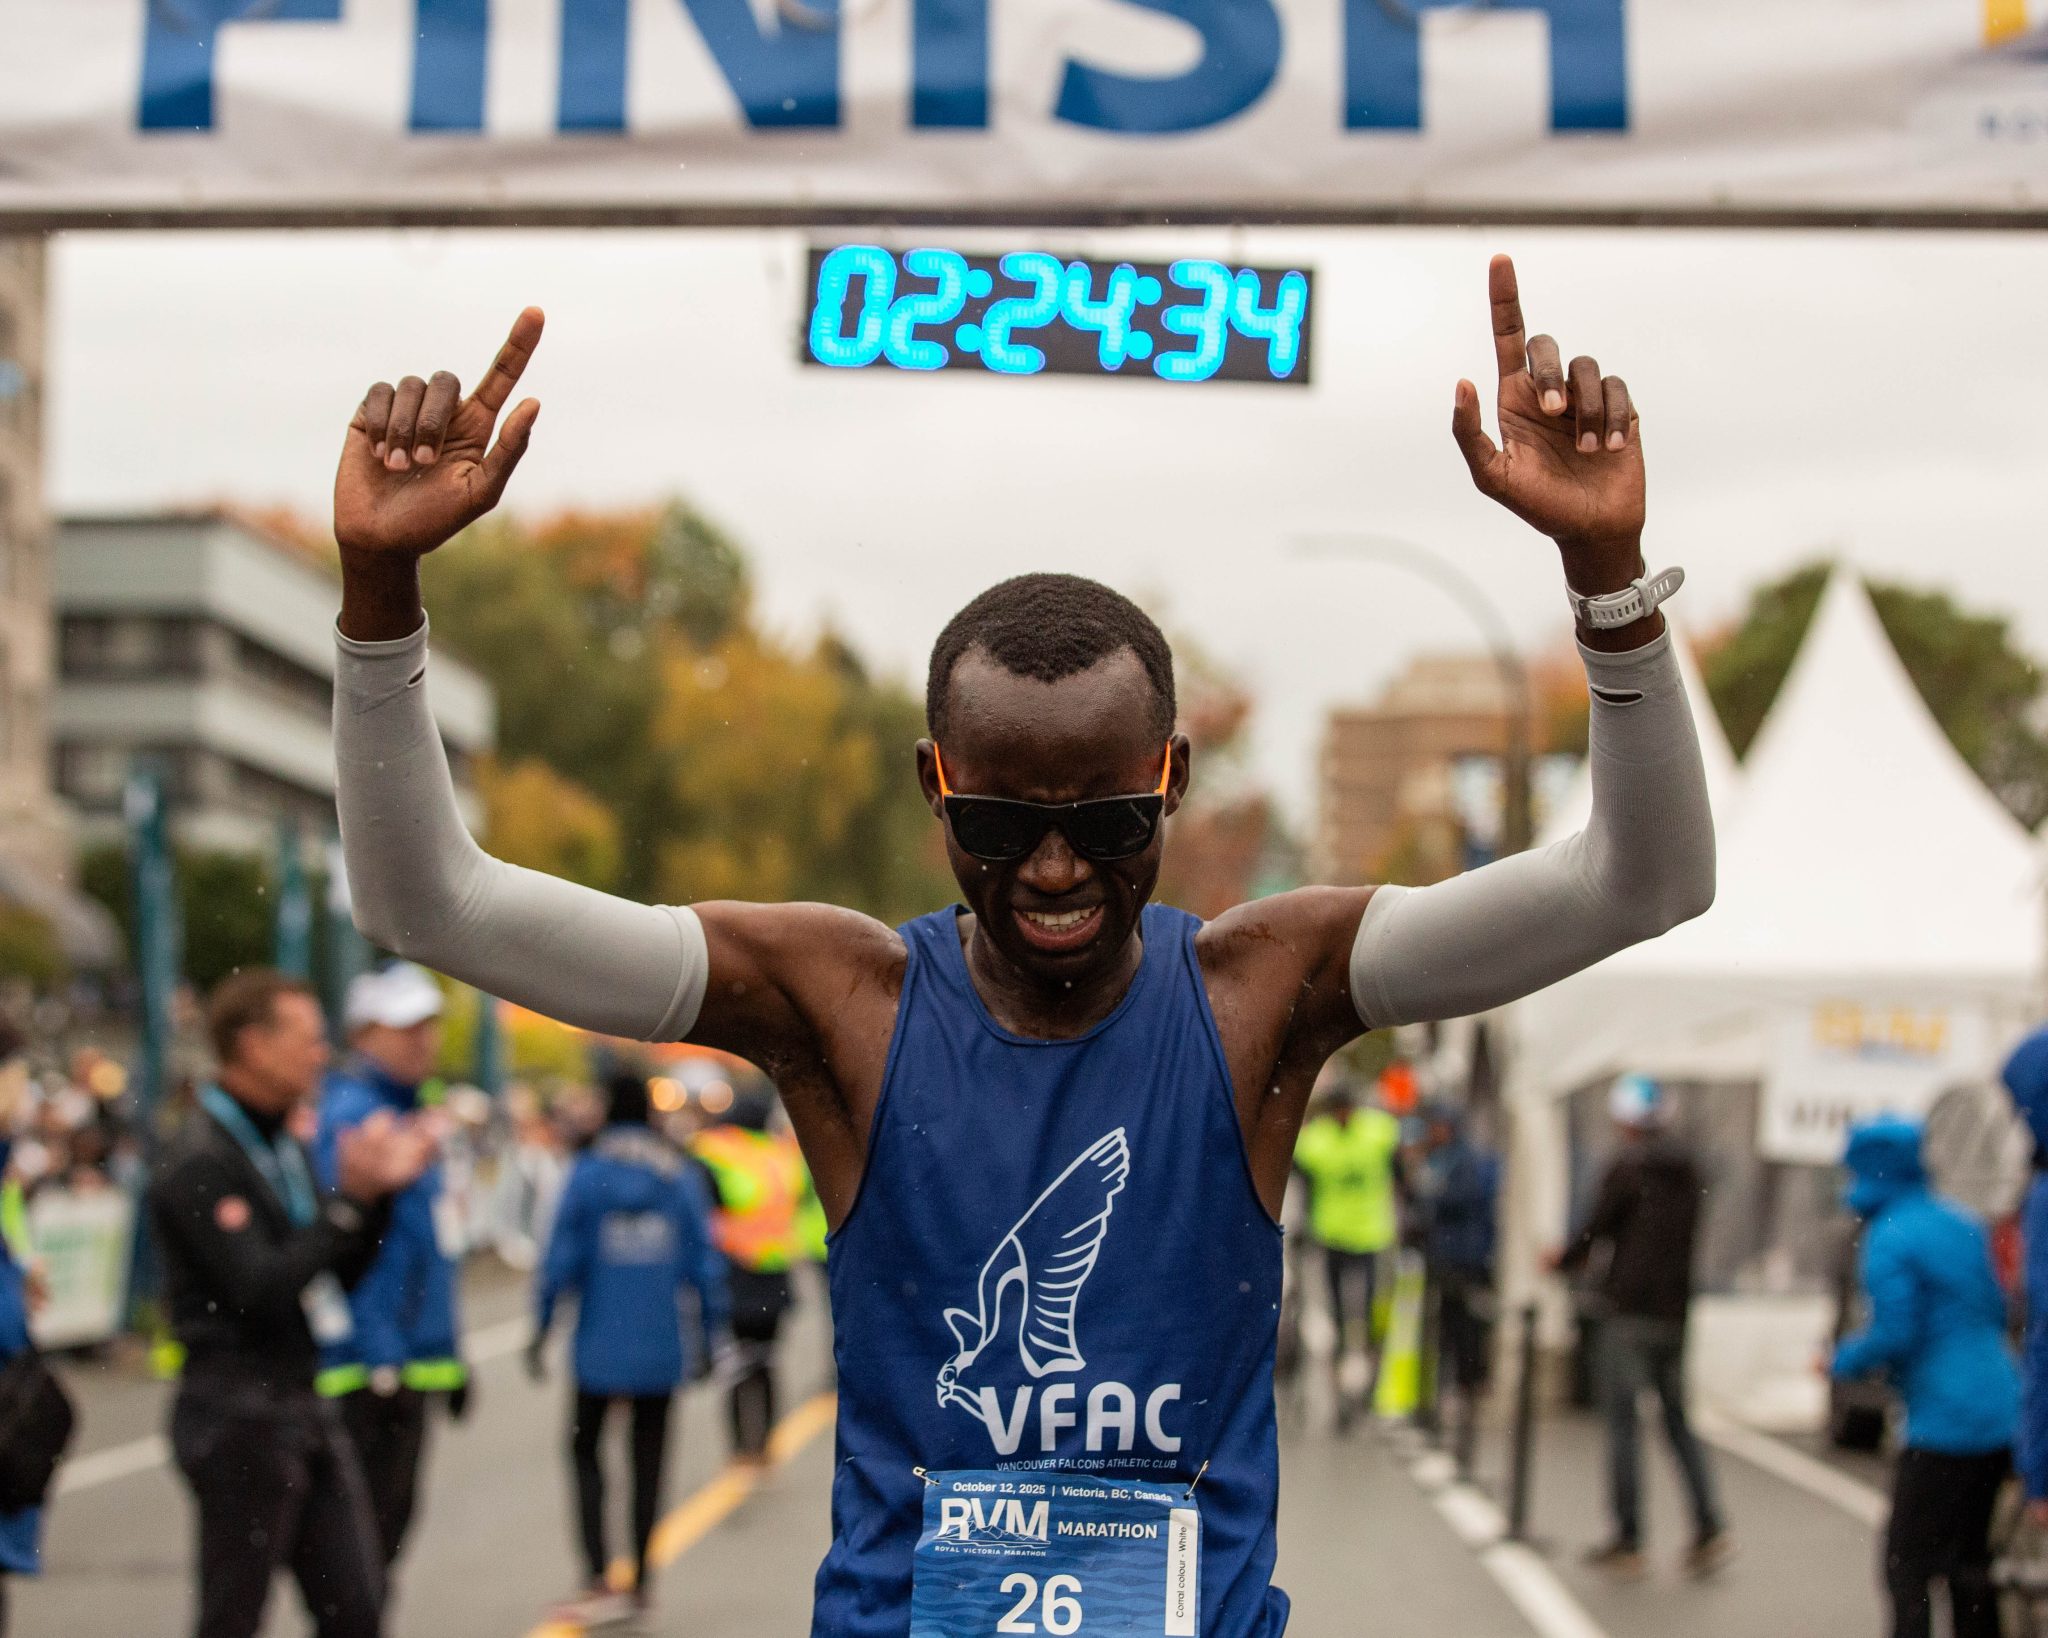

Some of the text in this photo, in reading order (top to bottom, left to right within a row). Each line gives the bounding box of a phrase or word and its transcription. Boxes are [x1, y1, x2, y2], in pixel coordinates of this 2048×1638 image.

[809, 245, 1307, 381] 02:24:34
[979, 1381, 1181, 1455] VFAC
[996, 1458, 1178, 1471] VANCOUVER FALCONS ATHLETIC CLUB
[953, 1481, 997, 1492] October
[1000, 1483, 1016, 1494] 12,
[1019, 1484, 1046, 1495] 2025
[1062, 1486, 1108, 1500] Victoria,
[1111, 1489, 1131, 1501] BC,
[1134, 1490, 1174, 1503] Canada
[937, 1497, 1050, 1541] RVM
[1057, 1521, 1159, 1539] MARATHON
[934, 1545, 1047, 1557] ROYAL VICTORIA MARATHON
[1179, 1526, 1187, 1551] White
[1176, 1560, 1186, 1588] colour
[997, 1572, 1083, 1636] 26
[1176, 1591, 1184, 1618] Corral
